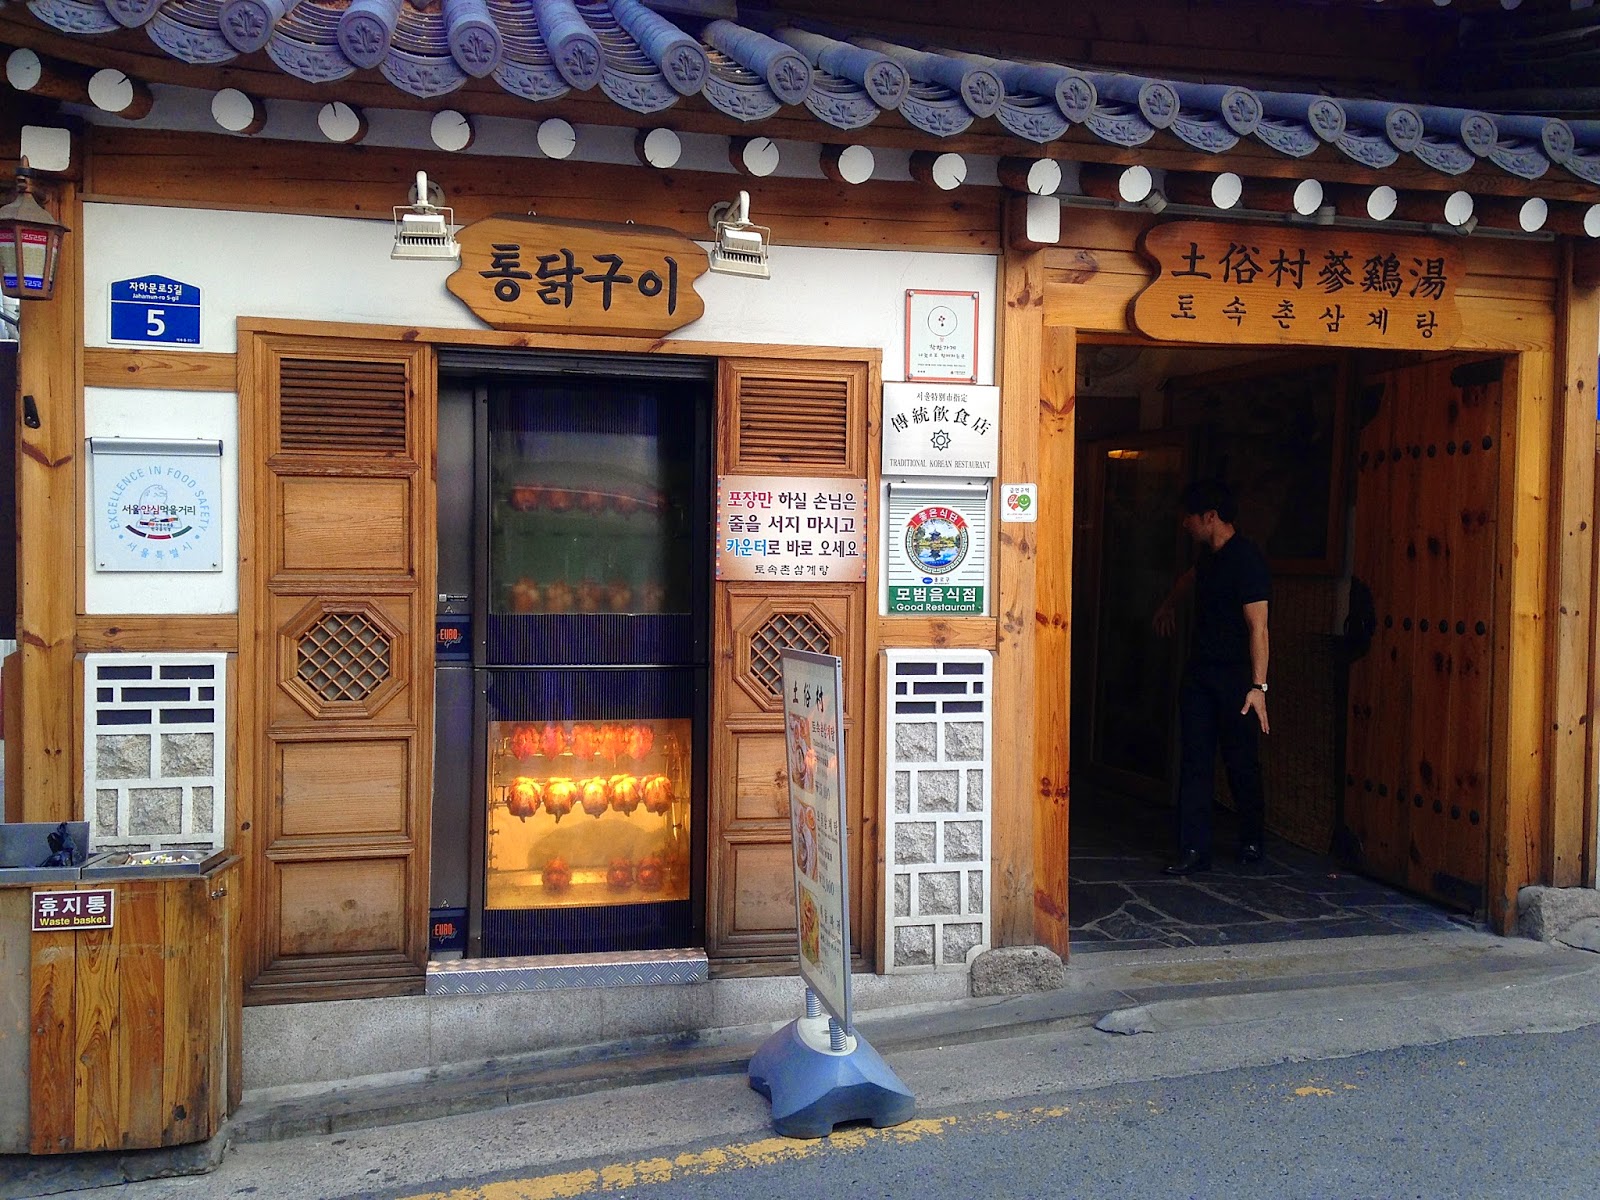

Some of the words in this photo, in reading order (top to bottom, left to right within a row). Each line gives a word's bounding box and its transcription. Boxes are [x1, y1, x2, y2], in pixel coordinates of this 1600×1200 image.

[478, 243, 678, 316] 통닭구이
[129, 281, 182, 296] 자하문로5길
[133, 293, 165, 301] Jahamun-ro
[166, 295, 180, 303] 5-gil
[146, 308, 165, 336] 5
[1171, 294, 1438, 338] 토속촌삼계탕
[890, 459, 927, 467] TRADITIONAL
[929, 460, 953, 468] KOREAN
[954, 461, 991, 469] RESTAURANT
[108, 468, 145, 530] EXCELLENCE
[149, 466, 162, 475] IN
[167, 467, 197, 488] FOOD
[195, 490, 210, 532] SAFETY
[728, 491, 773, 509] 포장만
[778, 492, 807, 510] 하실
[813, 492, 857, 511] 손님은
[122, 504, 196, 516] 서울안심먹을거리
[918, 508, 958, 522] 좋은식단
[728, 514, 761, 533] 줄을
[768, 515, 800, 533] 서지
[807, 516, 856, 534] 마시고
[726, 538, 781, 557] 카운터로
[787, 540, 814, 557] 바로
[818, 540, 859, 557] 오세요
[754, 564, 830, 576] 토속촌삼계탕
[895, 587, 976, 602] 모범음식점
[896, 603, 923, 611] Good
[926, 603, 975, 611] Restaurant
[440, 628, 458, 640] EURO
[792, 680, 824, 713] 土俗村
[38, 895, 107, 917] 휴지통
[39, 917, 70, 926] Waste
[73, 915, 107, 925] basket
[434, 923, 453, 936] EURO
